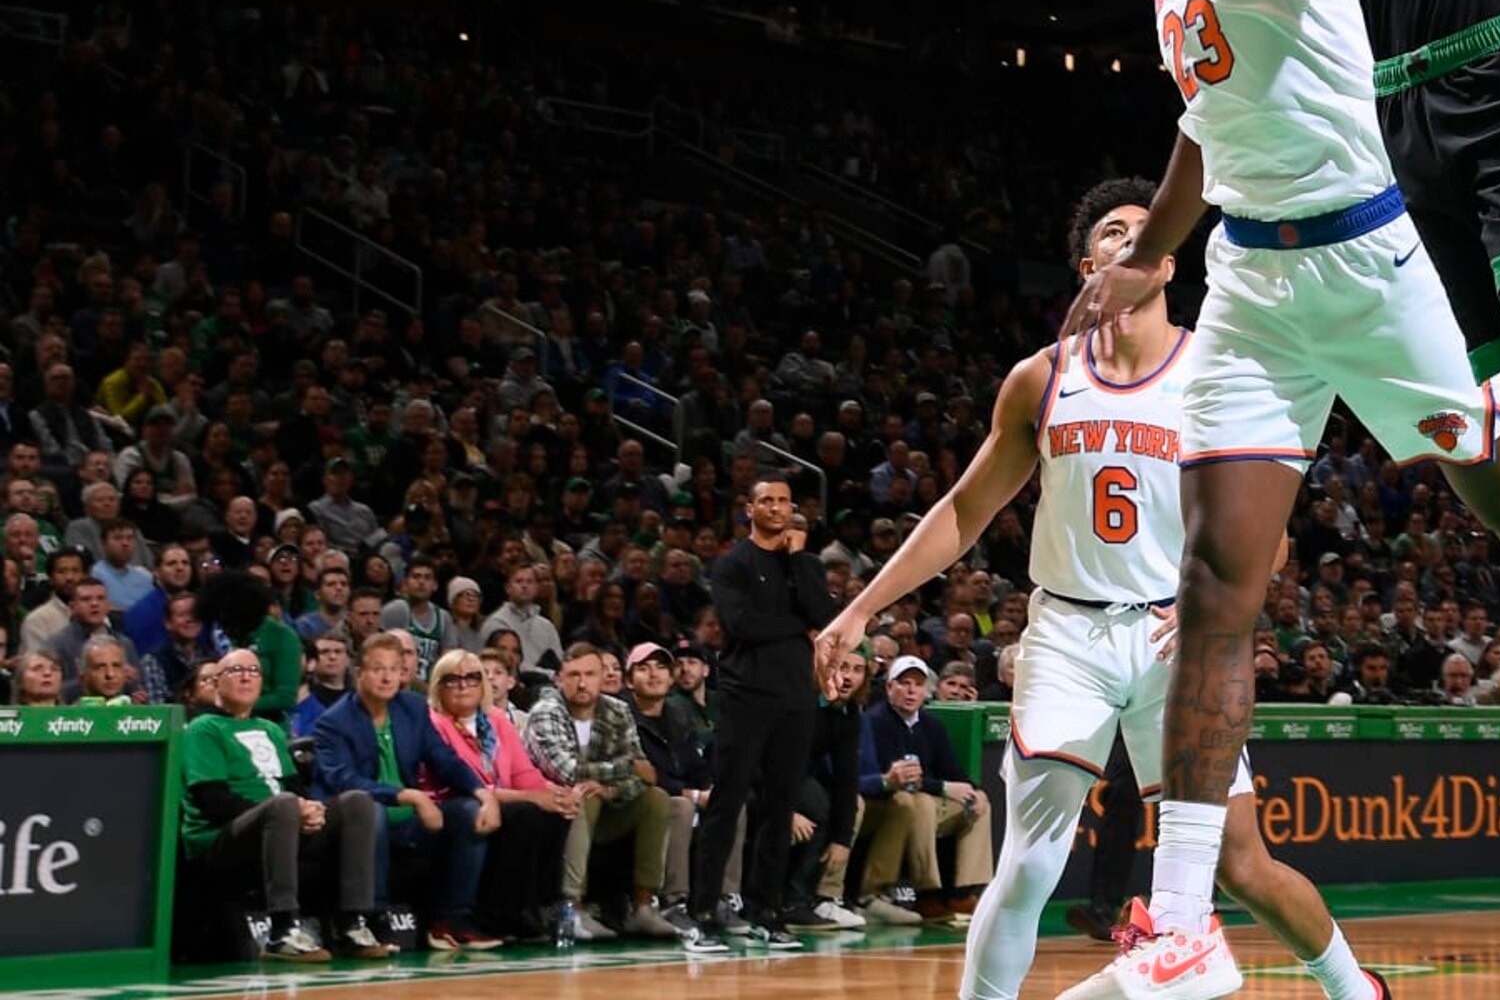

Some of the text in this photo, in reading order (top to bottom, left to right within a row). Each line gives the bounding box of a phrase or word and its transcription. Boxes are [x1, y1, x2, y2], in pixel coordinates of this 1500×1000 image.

[1048, 420, 1110, 458] NEW
[1093, 466, 1139, 544] 6
[47, 716, 94, 737] xfinity
[117, 715, 162, 735] xfinity
